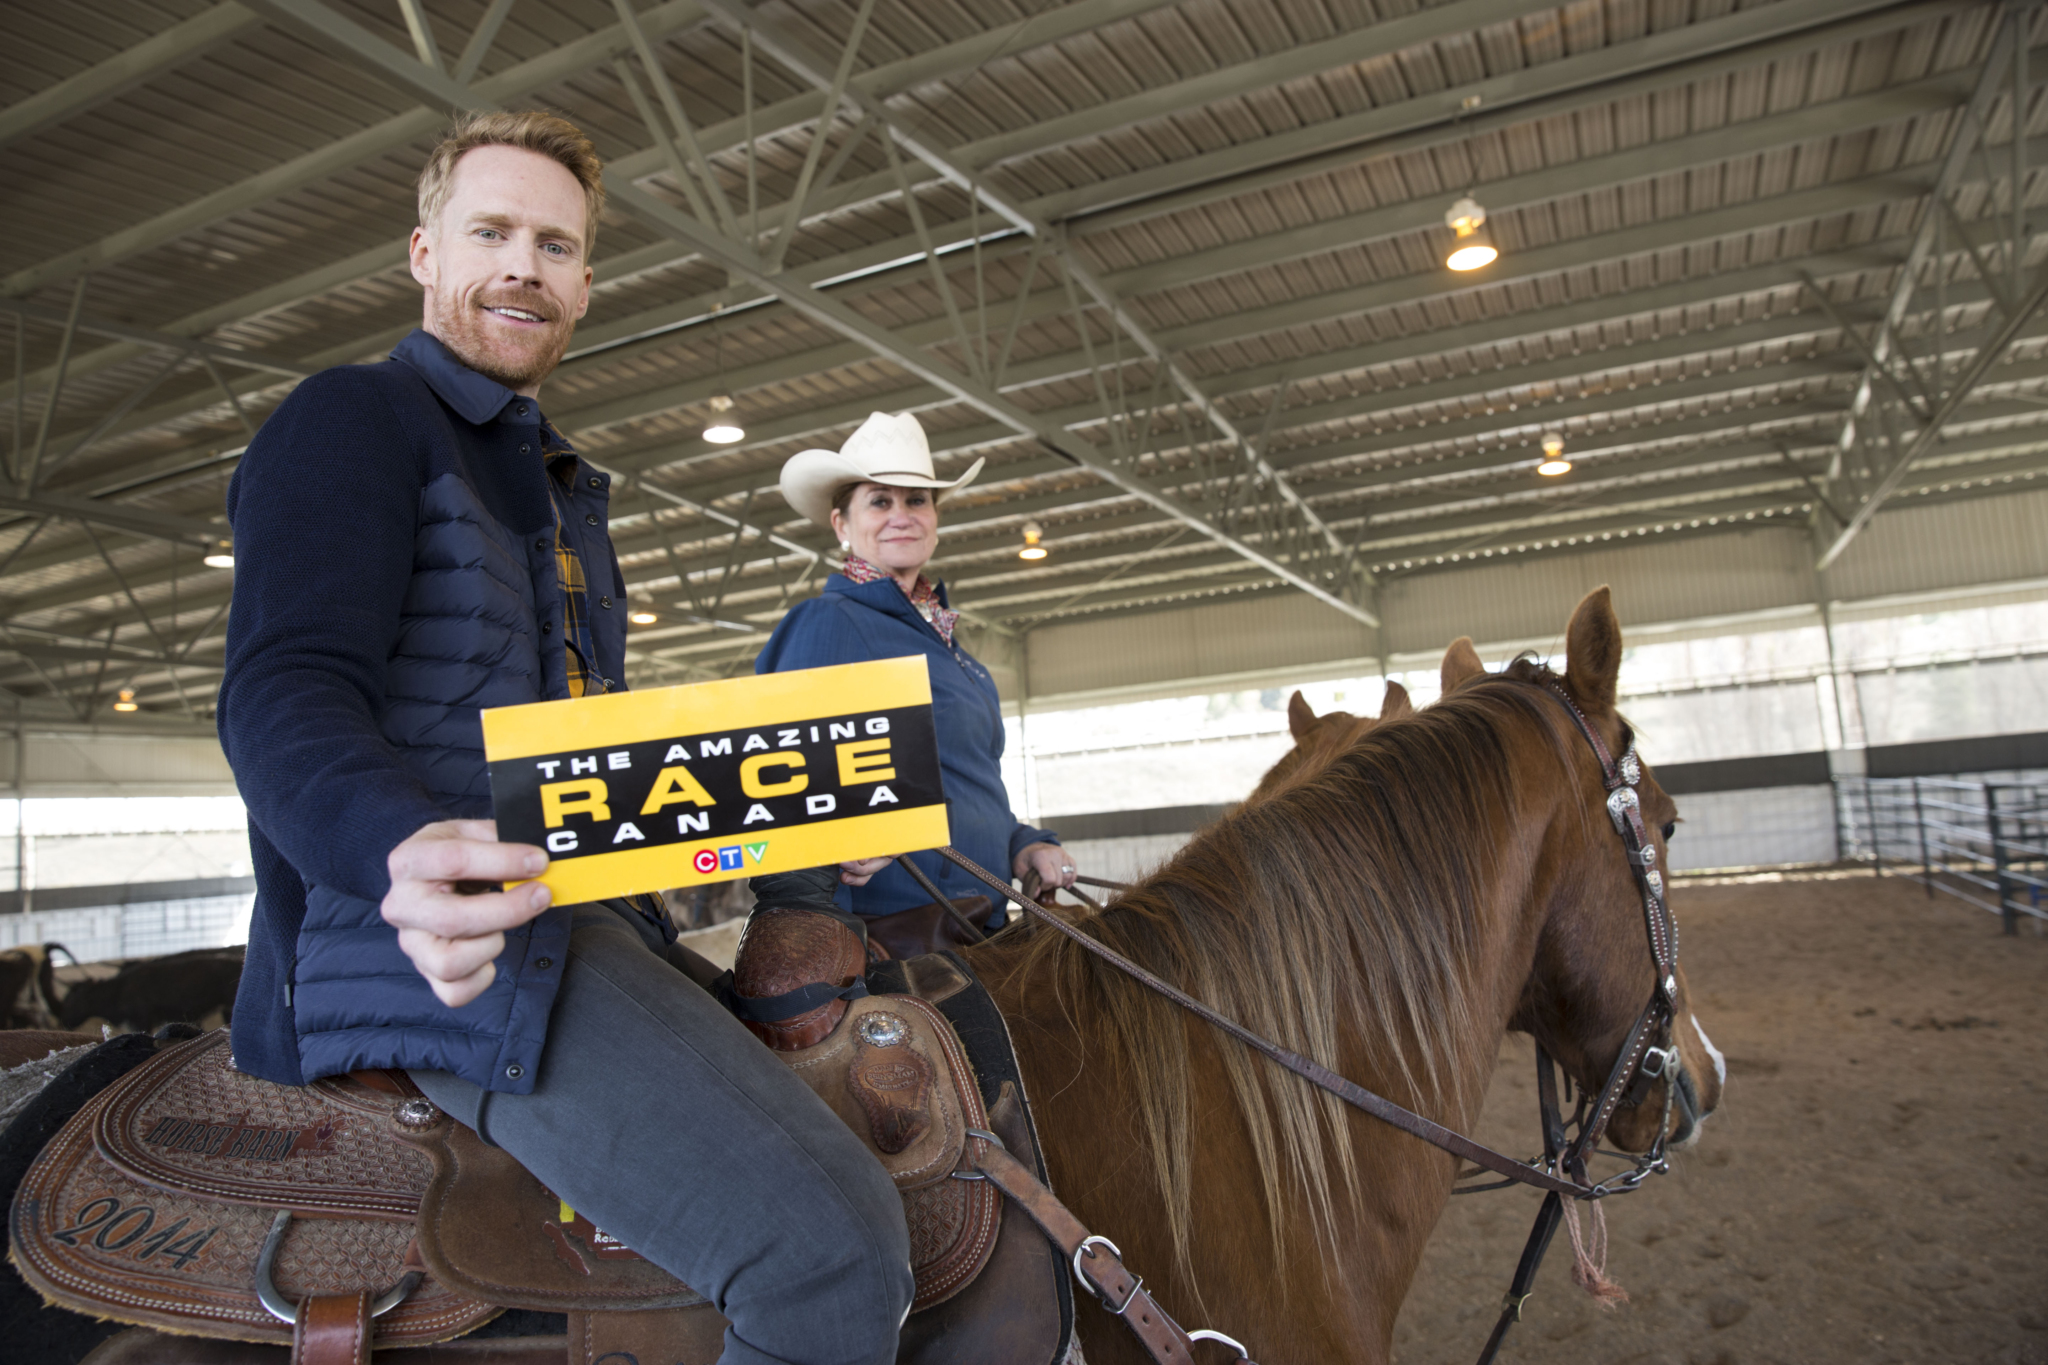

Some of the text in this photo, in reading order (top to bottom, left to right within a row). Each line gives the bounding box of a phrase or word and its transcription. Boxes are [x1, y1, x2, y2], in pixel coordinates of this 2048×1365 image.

[537, 716, 891, 779] THE AMAZING
[540, 737, 897, 829] RACE
[547, 785, 900, 853] CANADA
[694, 842, 768, 873] CTV
[145, 1117, 300, 1161] HORSE BARN
[53, 1197, 218, 1269] 2014
